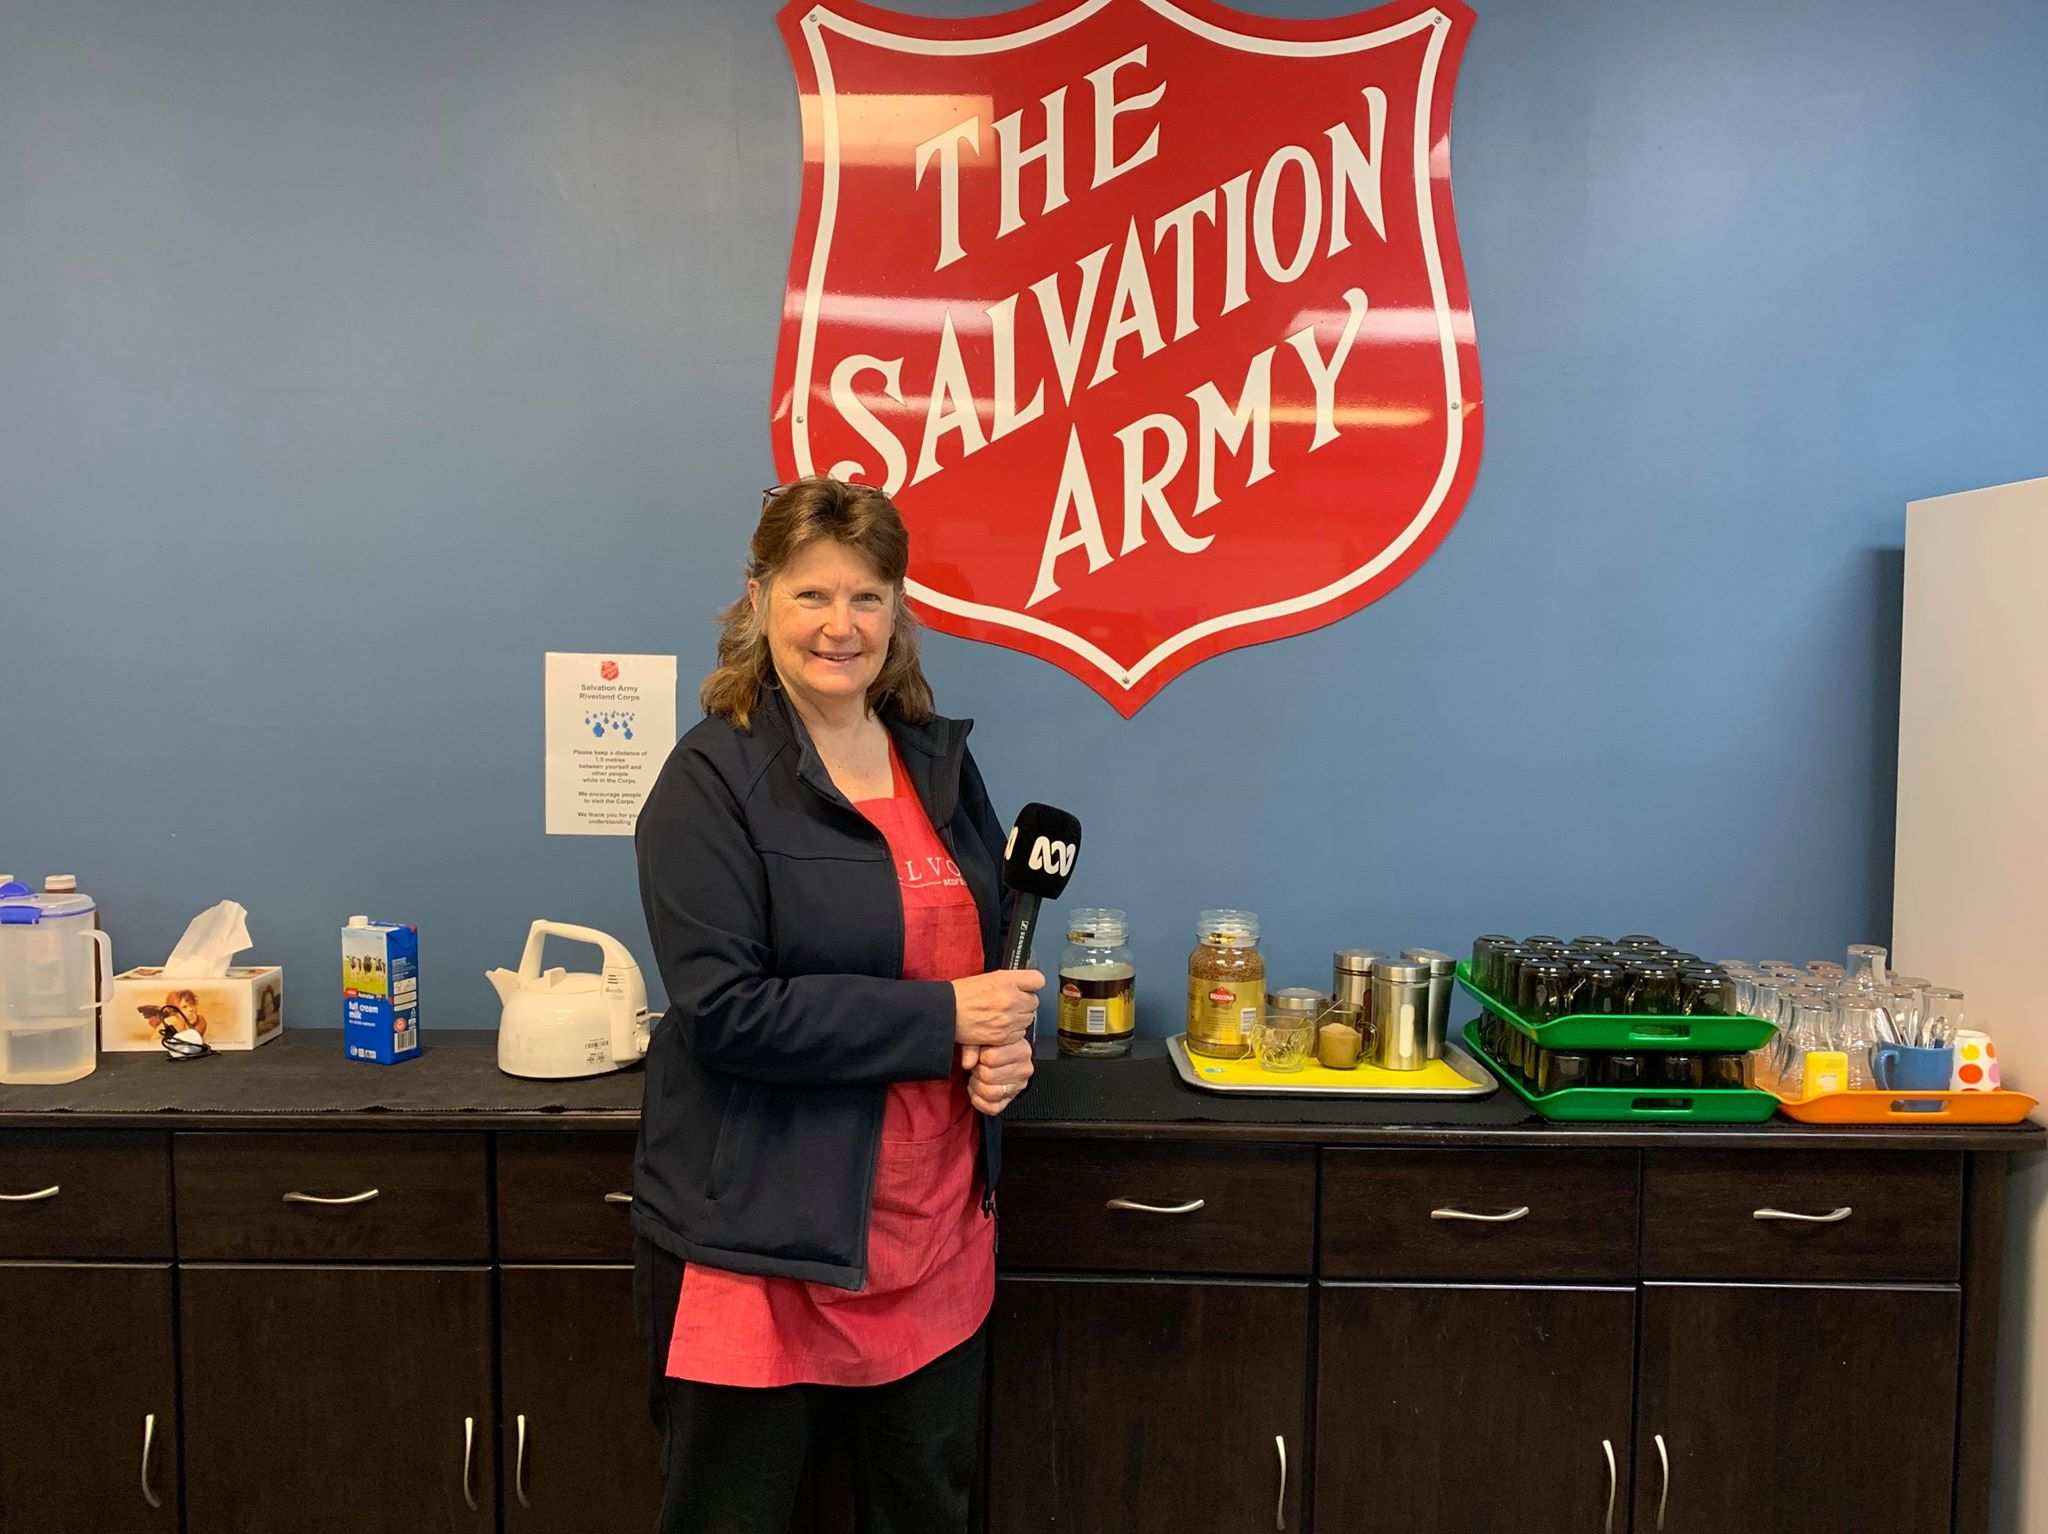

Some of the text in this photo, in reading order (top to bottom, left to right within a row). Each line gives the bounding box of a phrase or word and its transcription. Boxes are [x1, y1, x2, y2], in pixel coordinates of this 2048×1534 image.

[914, 43, 1167, 272] THE
[827, 85, 1388, 499] SALVATION
[1024, 286, 1369, 609] ARMY
[579, 692, 640, 702] Riverland Corps
[618, 685, 638, 693] Army
